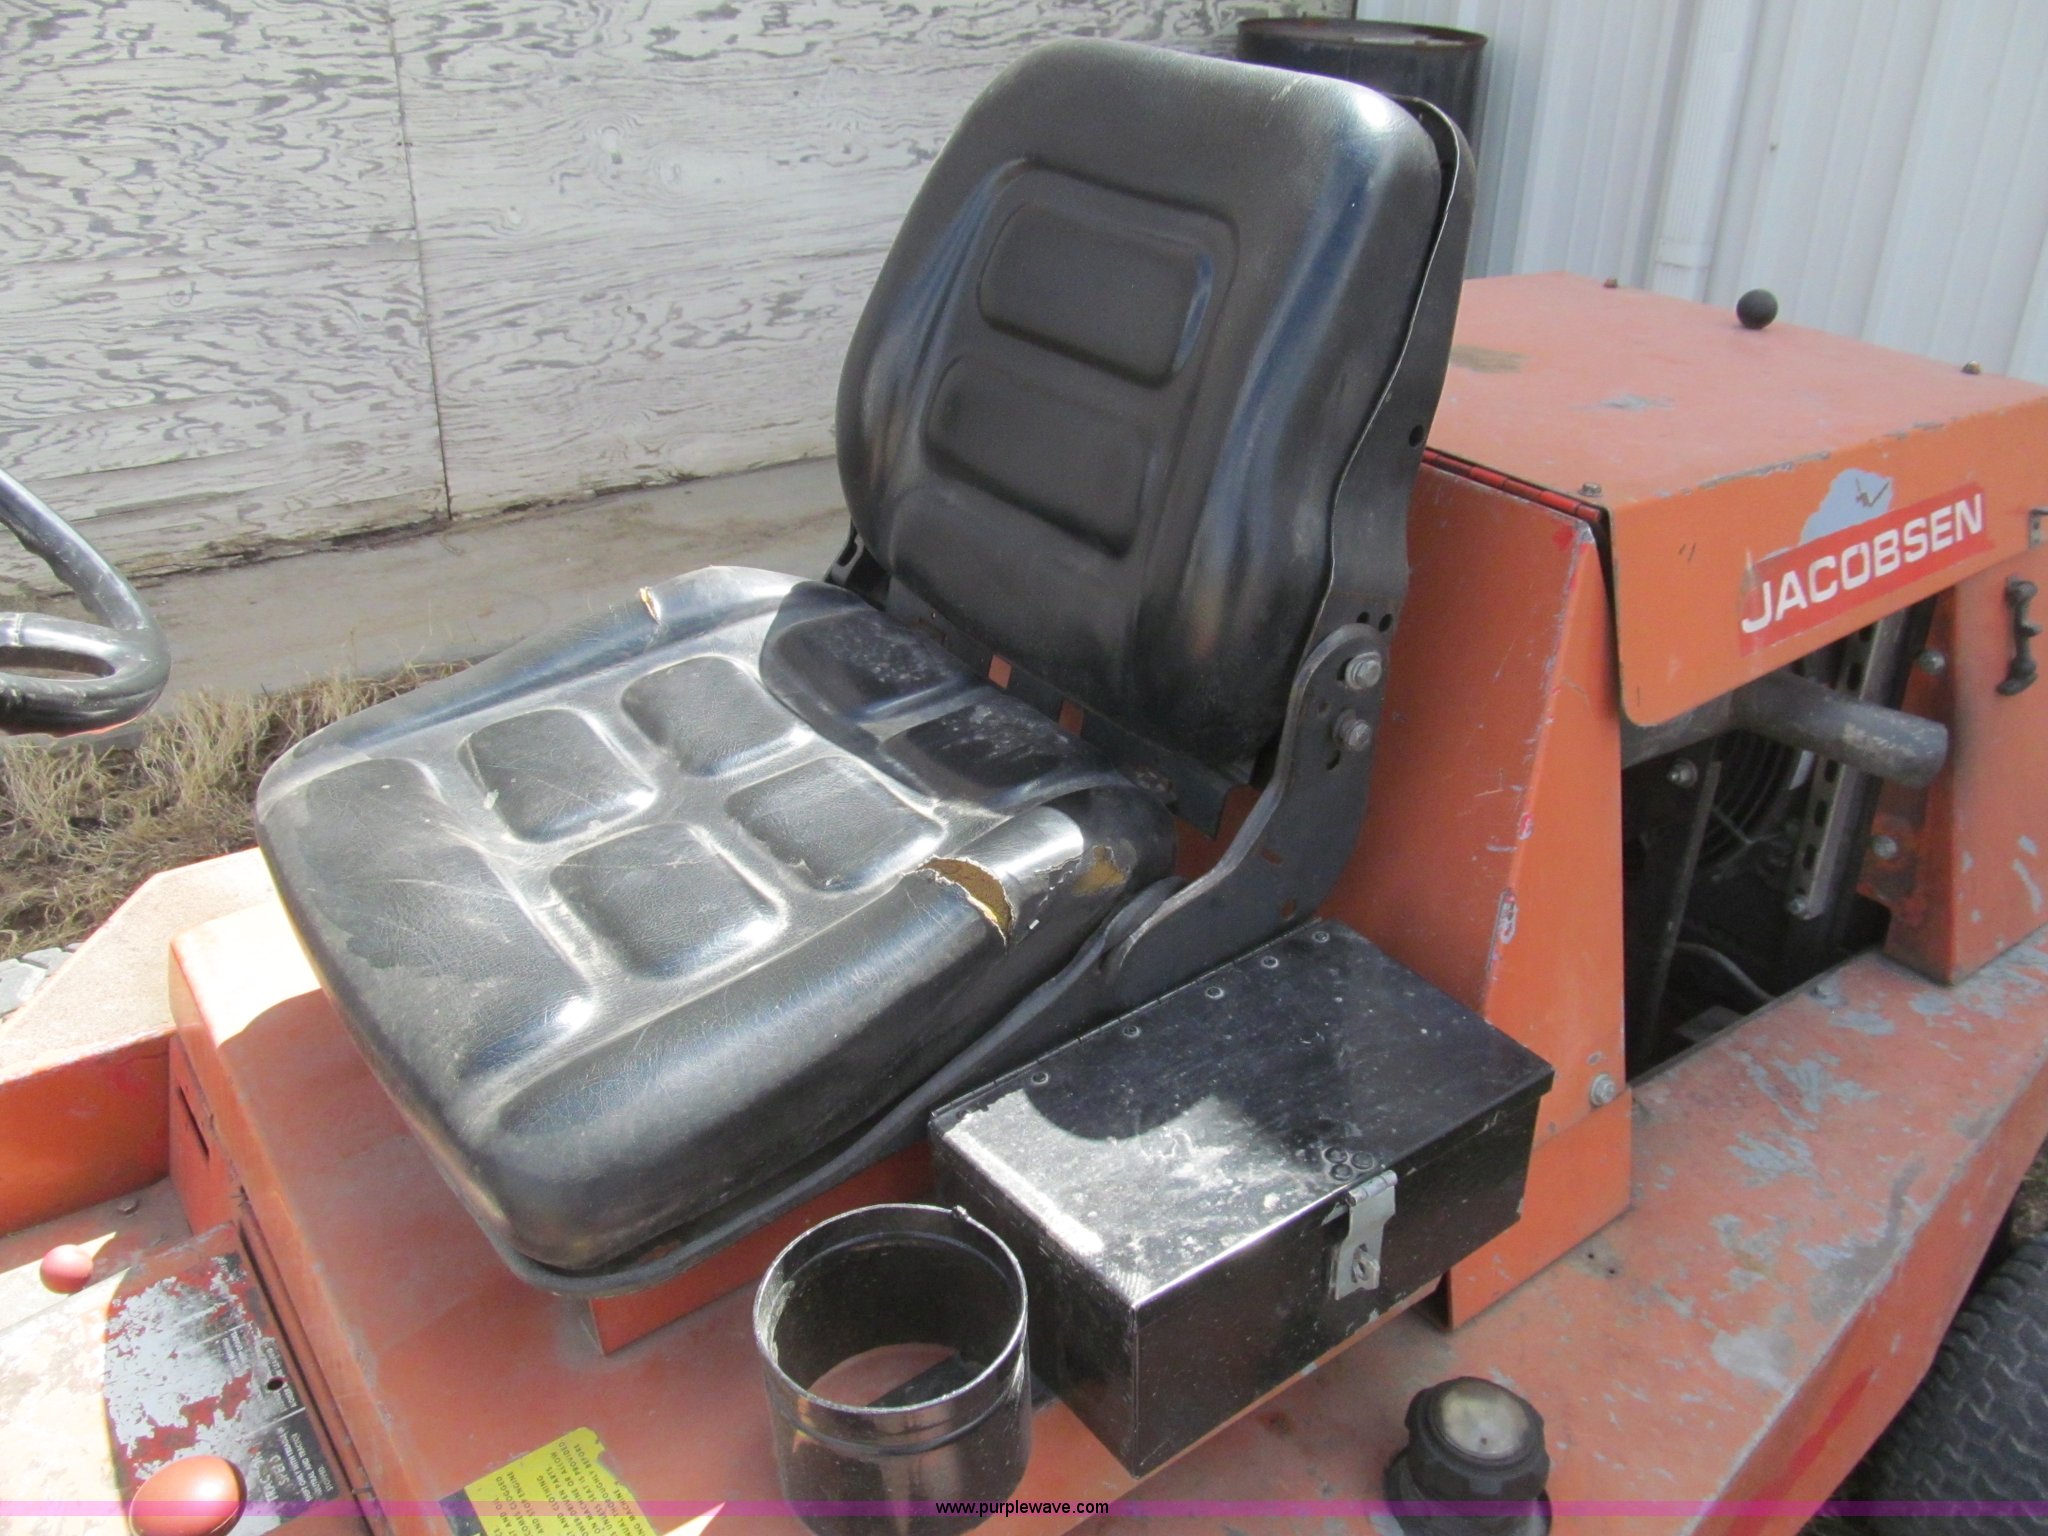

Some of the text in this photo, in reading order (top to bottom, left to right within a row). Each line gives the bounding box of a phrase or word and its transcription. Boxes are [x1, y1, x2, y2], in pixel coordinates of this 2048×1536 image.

[1741, 493, 1983, 634] JACOBSEN
[301, 1457, 312, 1470] AND
[559, 1442, 580, 1475] PROVIDED
[574, 1444, 591, 1468] BEFORE
[496, 1477, 516, 1509] CLOGGED
[537, 1476, 558, 1510] CLOTHING
[547, 1467, 560, 1488] PARTS
[551, 1452, 600, 1533] ON MACHINE OR ALLOW
[507, 1472, 543, 1533] AND STOP ENGINE
[583, 1486, 596, 1502] SEAT
[590, 1471, 618, 1516] THOROUGHLY
[614, 1490, 635, 1521] MACHINE
[500, 1513, 511, 1527] AND
[557, 1515, 568, 1528] AND
[595, 1504, 612, 1530] UNLESS
